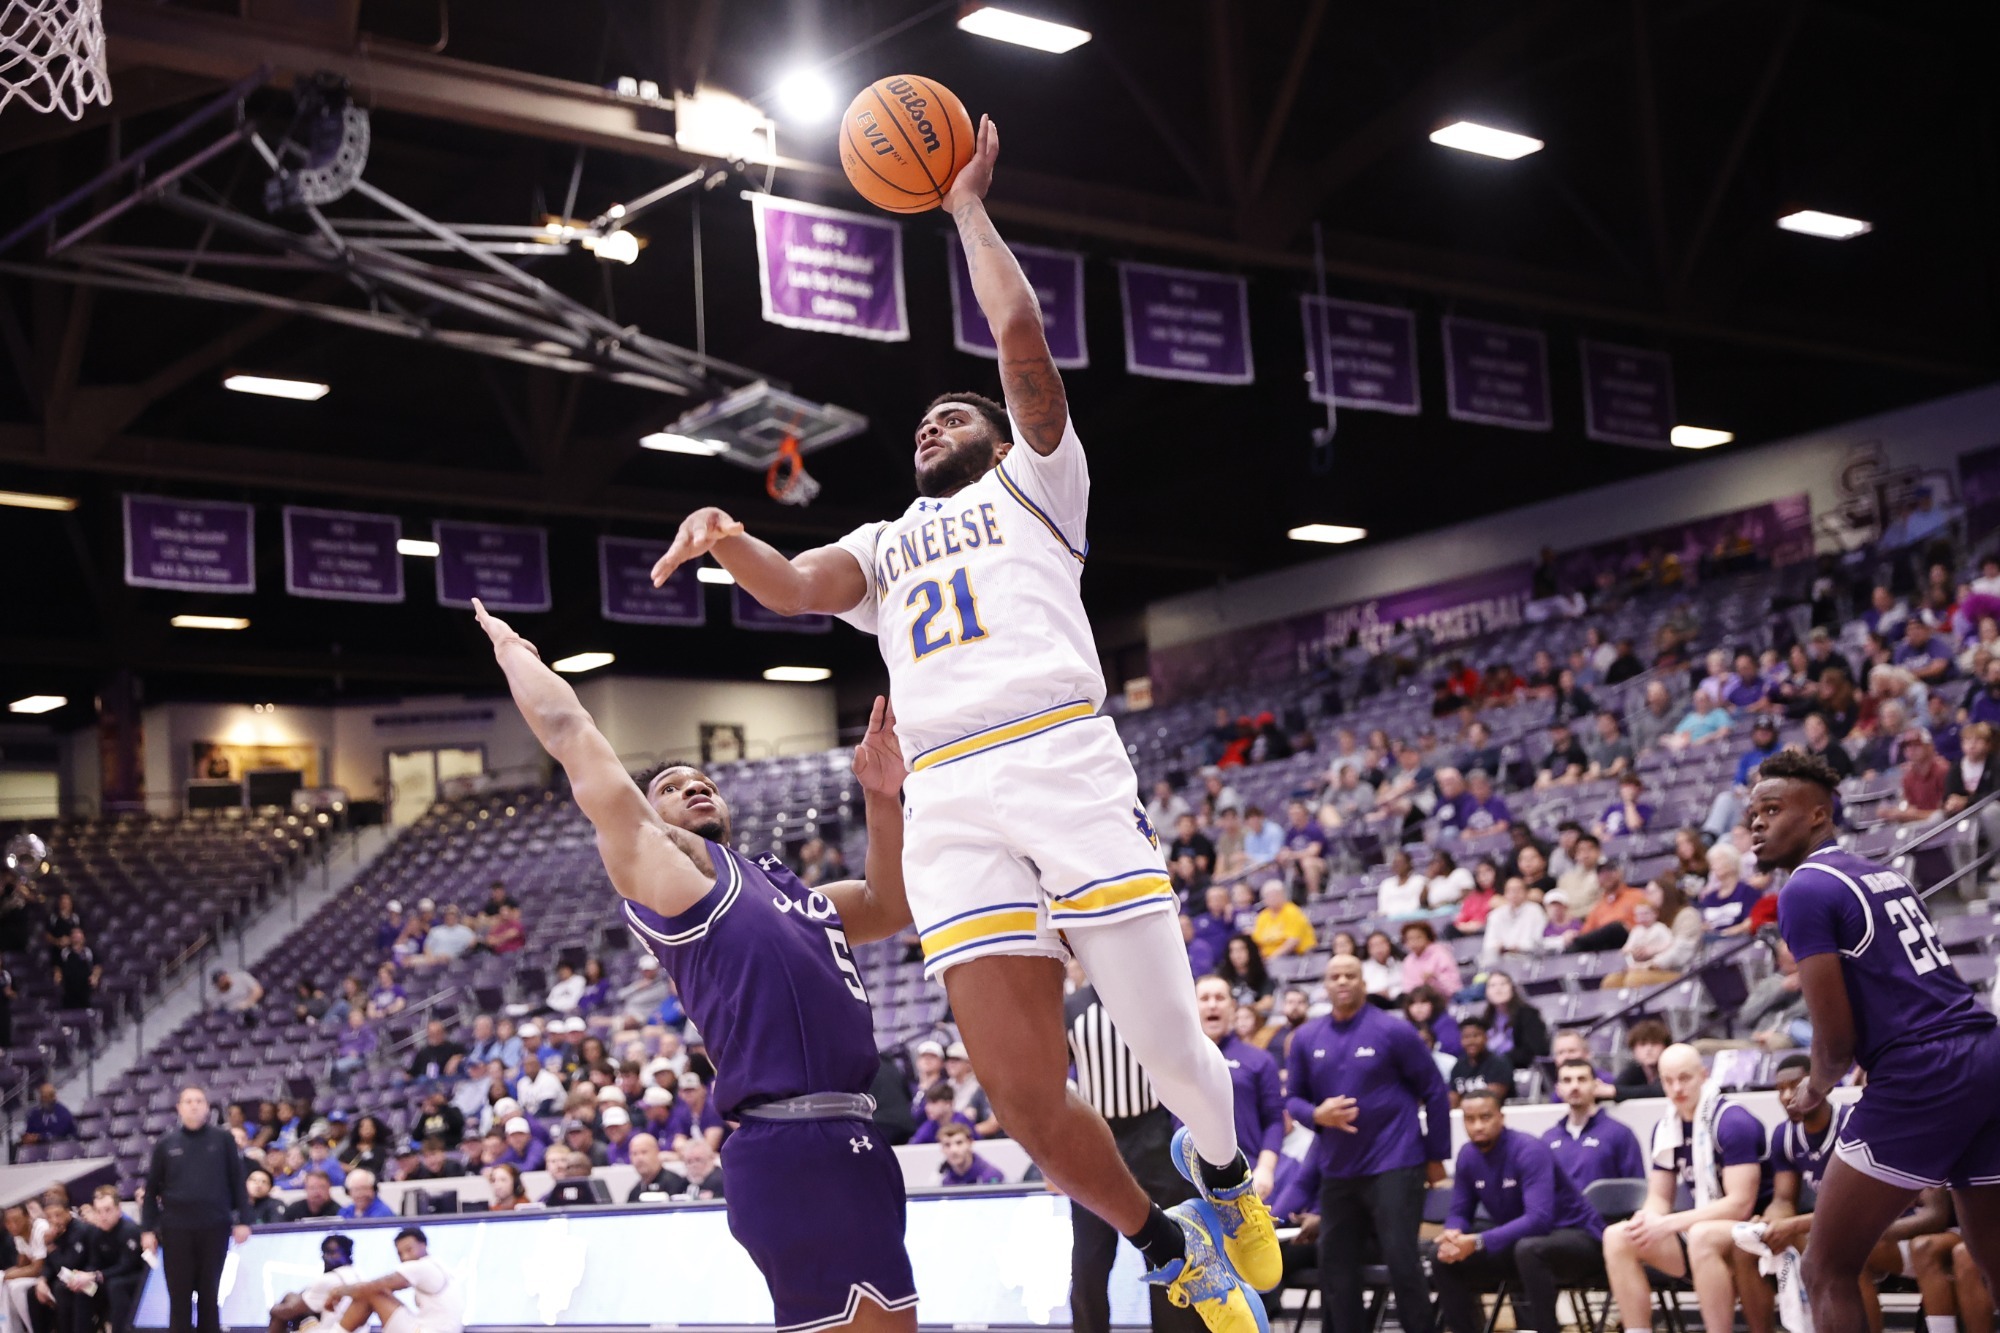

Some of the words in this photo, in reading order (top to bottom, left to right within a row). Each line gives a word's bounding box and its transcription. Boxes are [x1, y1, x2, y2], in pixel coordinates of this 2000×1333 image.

[885, 77, 941, 155] Wilson
[891, 150, 909, 167] NXT
[904, 565, 990, 663] 21
[824, 926, 869, 1004] 5
[1883, 896, 1952, 976] 22
